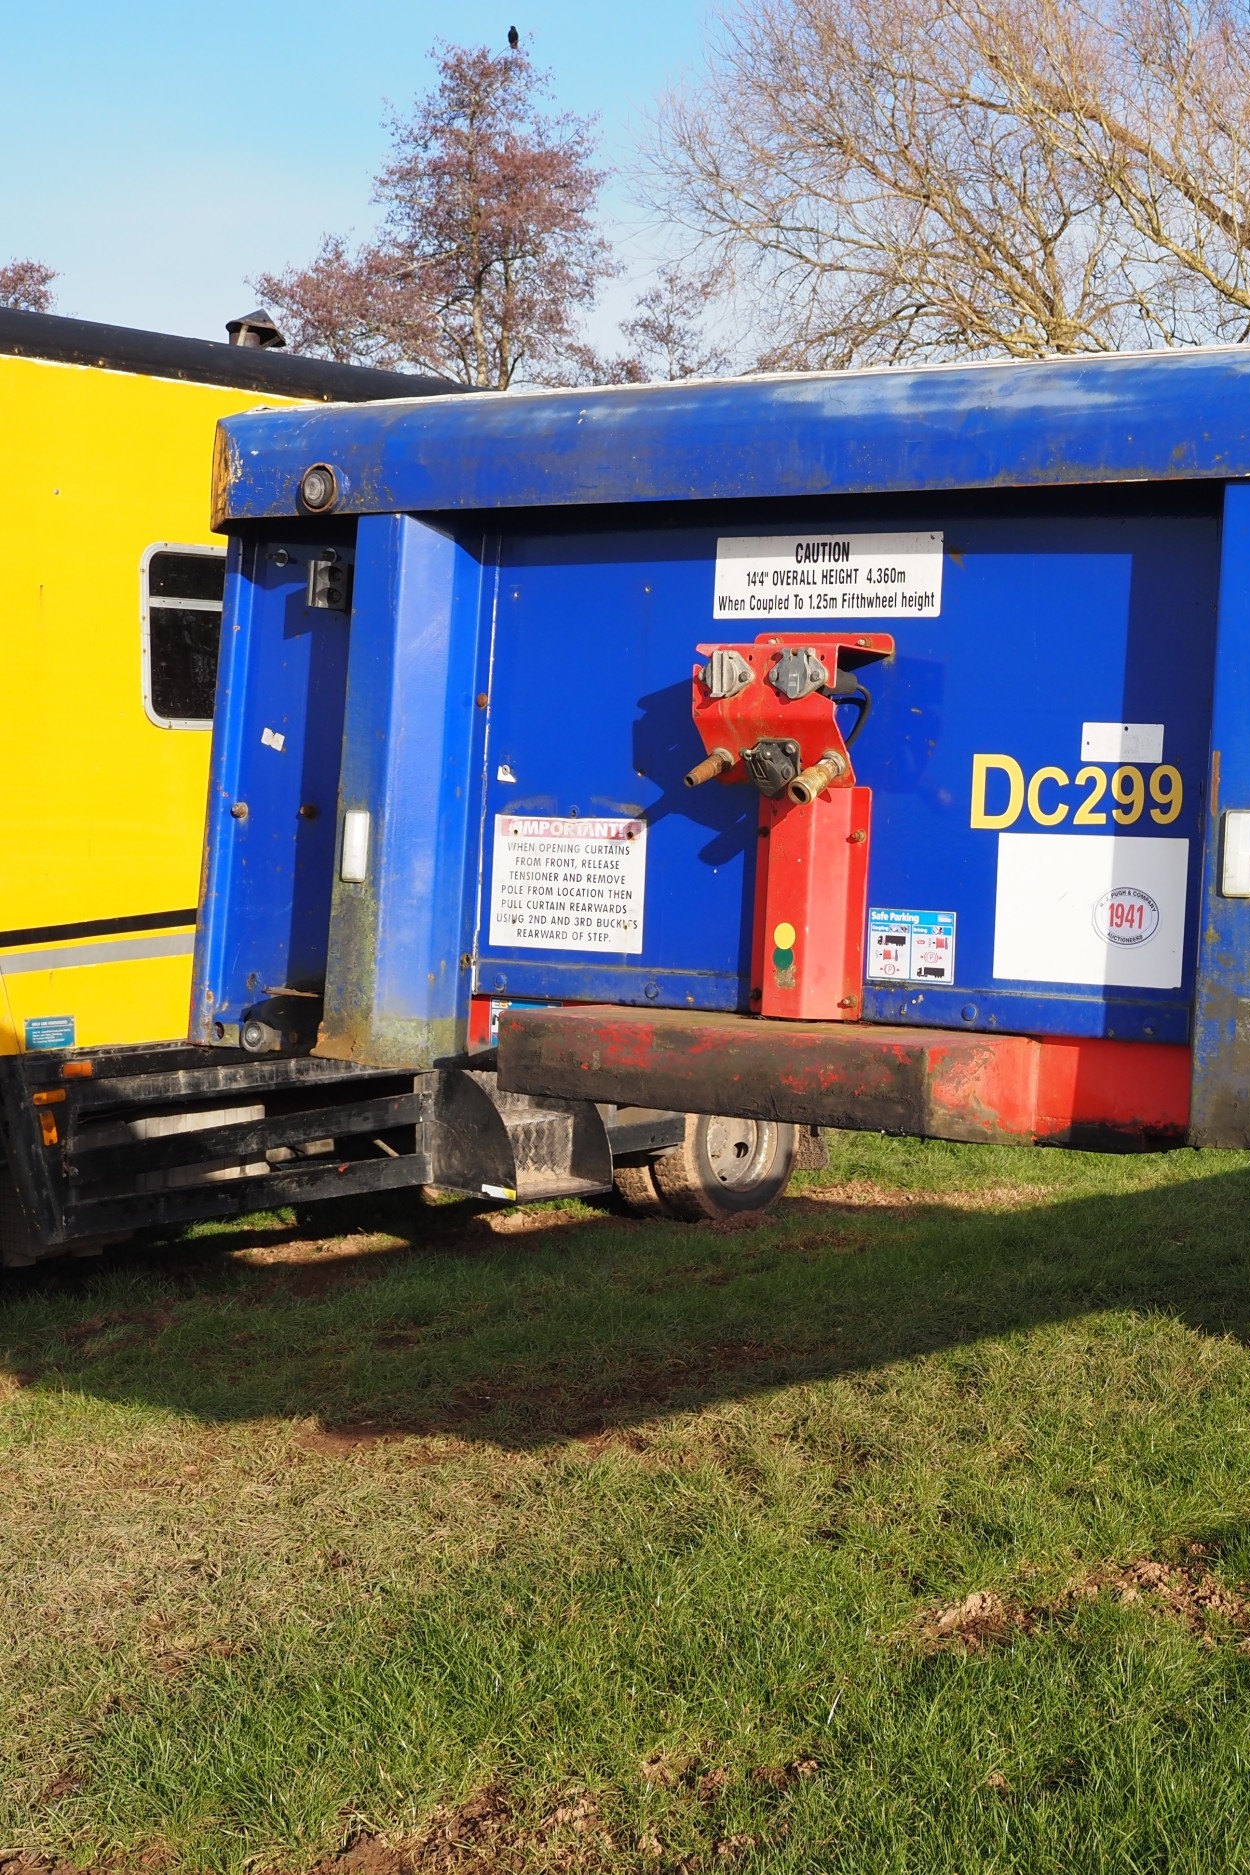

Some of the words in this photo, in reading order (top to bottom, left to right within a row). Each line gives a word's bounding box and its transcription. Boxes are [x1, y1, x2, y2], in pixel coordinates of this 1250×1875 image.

[795, 541, 850, 564] CAUTION
[772, 569, 818, 586] OVERALL
[821, 568, 859, 585] HEIGHT
[866, 567, 906, 584] 4.360m
[718, 594, 746, 611] When
[749, 594, 790, 614] Coupled
[793, 594, 804, 610] To
[808, 593, 838, 610] 1.25m
[841, 592, 898, 609] Fifthwheel
[901, 591, 935, 611] height
[507, 842, 535, 852] WHEN
[538, 843, 581, 854] OPENING
[584, 844, 630, 856] CURTAINS
[515, 856, 542, 867] FROM
[545, 857, 578, 870] FRONT,
[581, 859, 620, 870] RELEASE
[509, 870, 559, 882] TENSIONER
[562, 873, 583, 883] AND
[586, 873, 626, 884] REMOVE
[501, 884, 523, 895] POLE
[527, 885, 554, 896] FROM
[557, 887, 604, 899] LOCATION
[608, 889, 633, 900] THEN
[501, 899, 523, 909] PULL
[526, 900, 566, 911] CURTAIN
[569, 902, 627, 914] REARWARDS
[1110, 890, 1127, 899] PUGH
[1132, 891, 1157, 912] COMPANY
[496, 913, 525, 924] USING
[528, 914, 547, 925] 2ND
[550, 915, 571, 926] AND
[574, 917, 593, 927] 3RD
[871, 911, 889, 921] Safe
[889, 912, 920, 925] Parking
[1108, 903, 1144, 930] 1941
[516, 928, 568, 940] REARWARD
[571, 931, 584, 941] OF
[587, 932, 611, 943] STEP.
